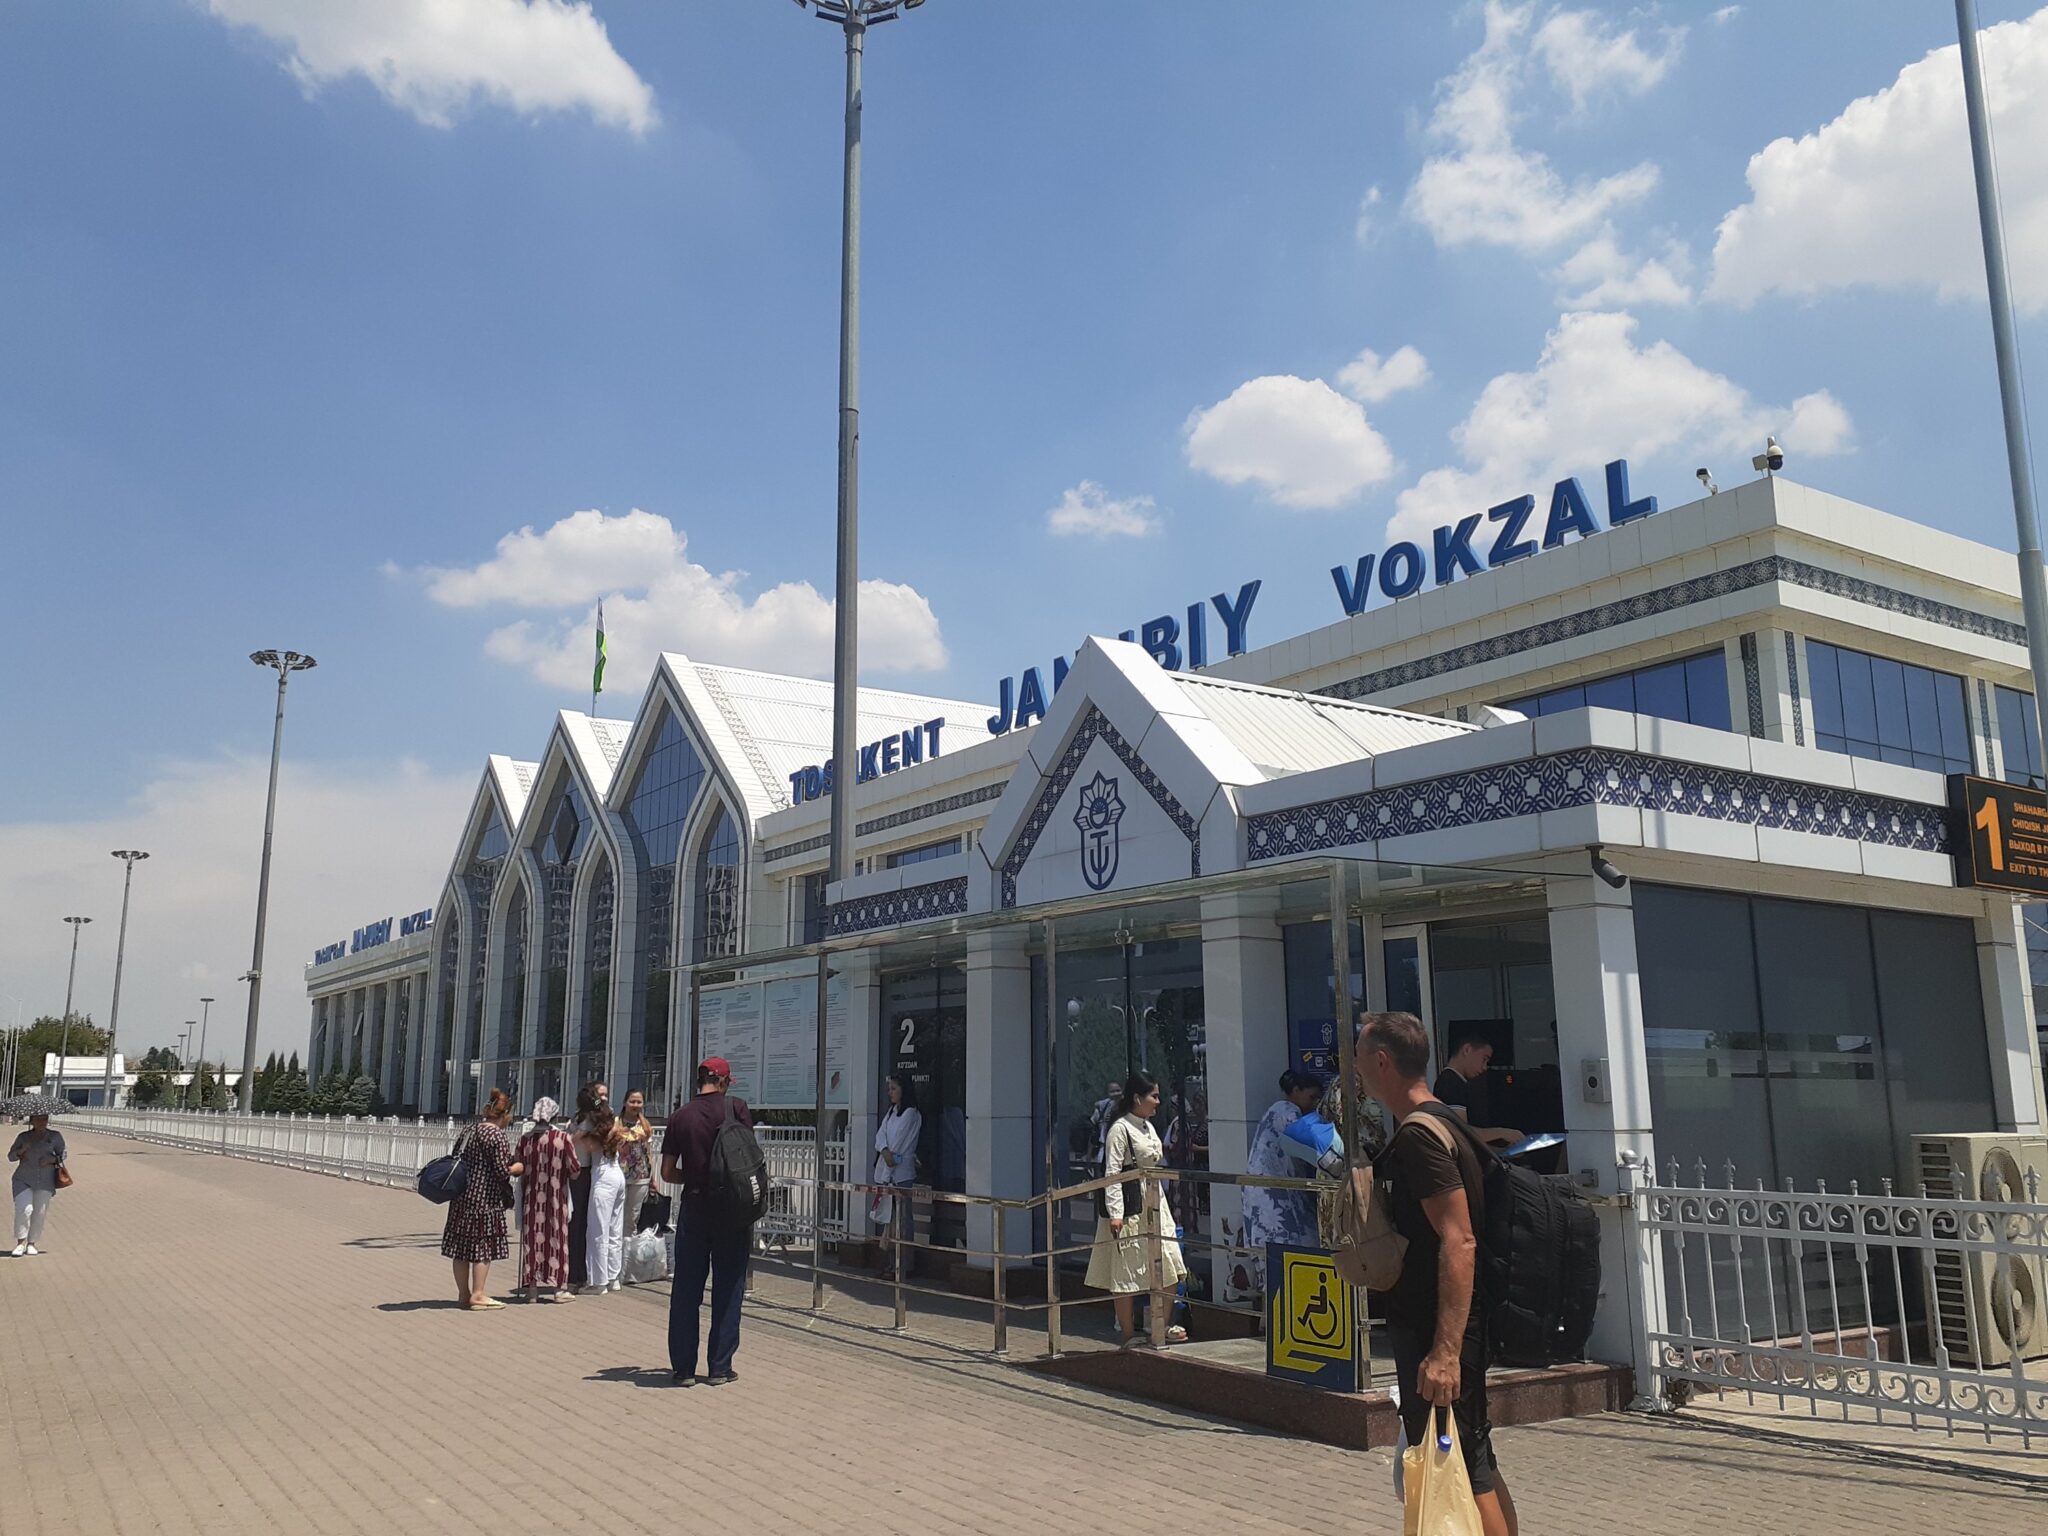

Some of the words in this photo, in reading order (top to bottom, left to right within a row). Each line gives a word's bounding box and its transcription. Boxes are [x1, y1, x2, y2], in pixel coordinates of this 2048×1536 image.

[789, 717, 945, 805] TOSKENT
[987, 580, 1262, 735] JABIY
[1330, 458, 1658, 617] VOKZAL
[1976, 796, 2004, 871] 1
[2009, 839, 2036, 855] ВЫХОД
[2009, 863, 2026, 875] EXIT
[2027, 865, 2038, 876] TO
[900, 1018, 915, 1054] 2
